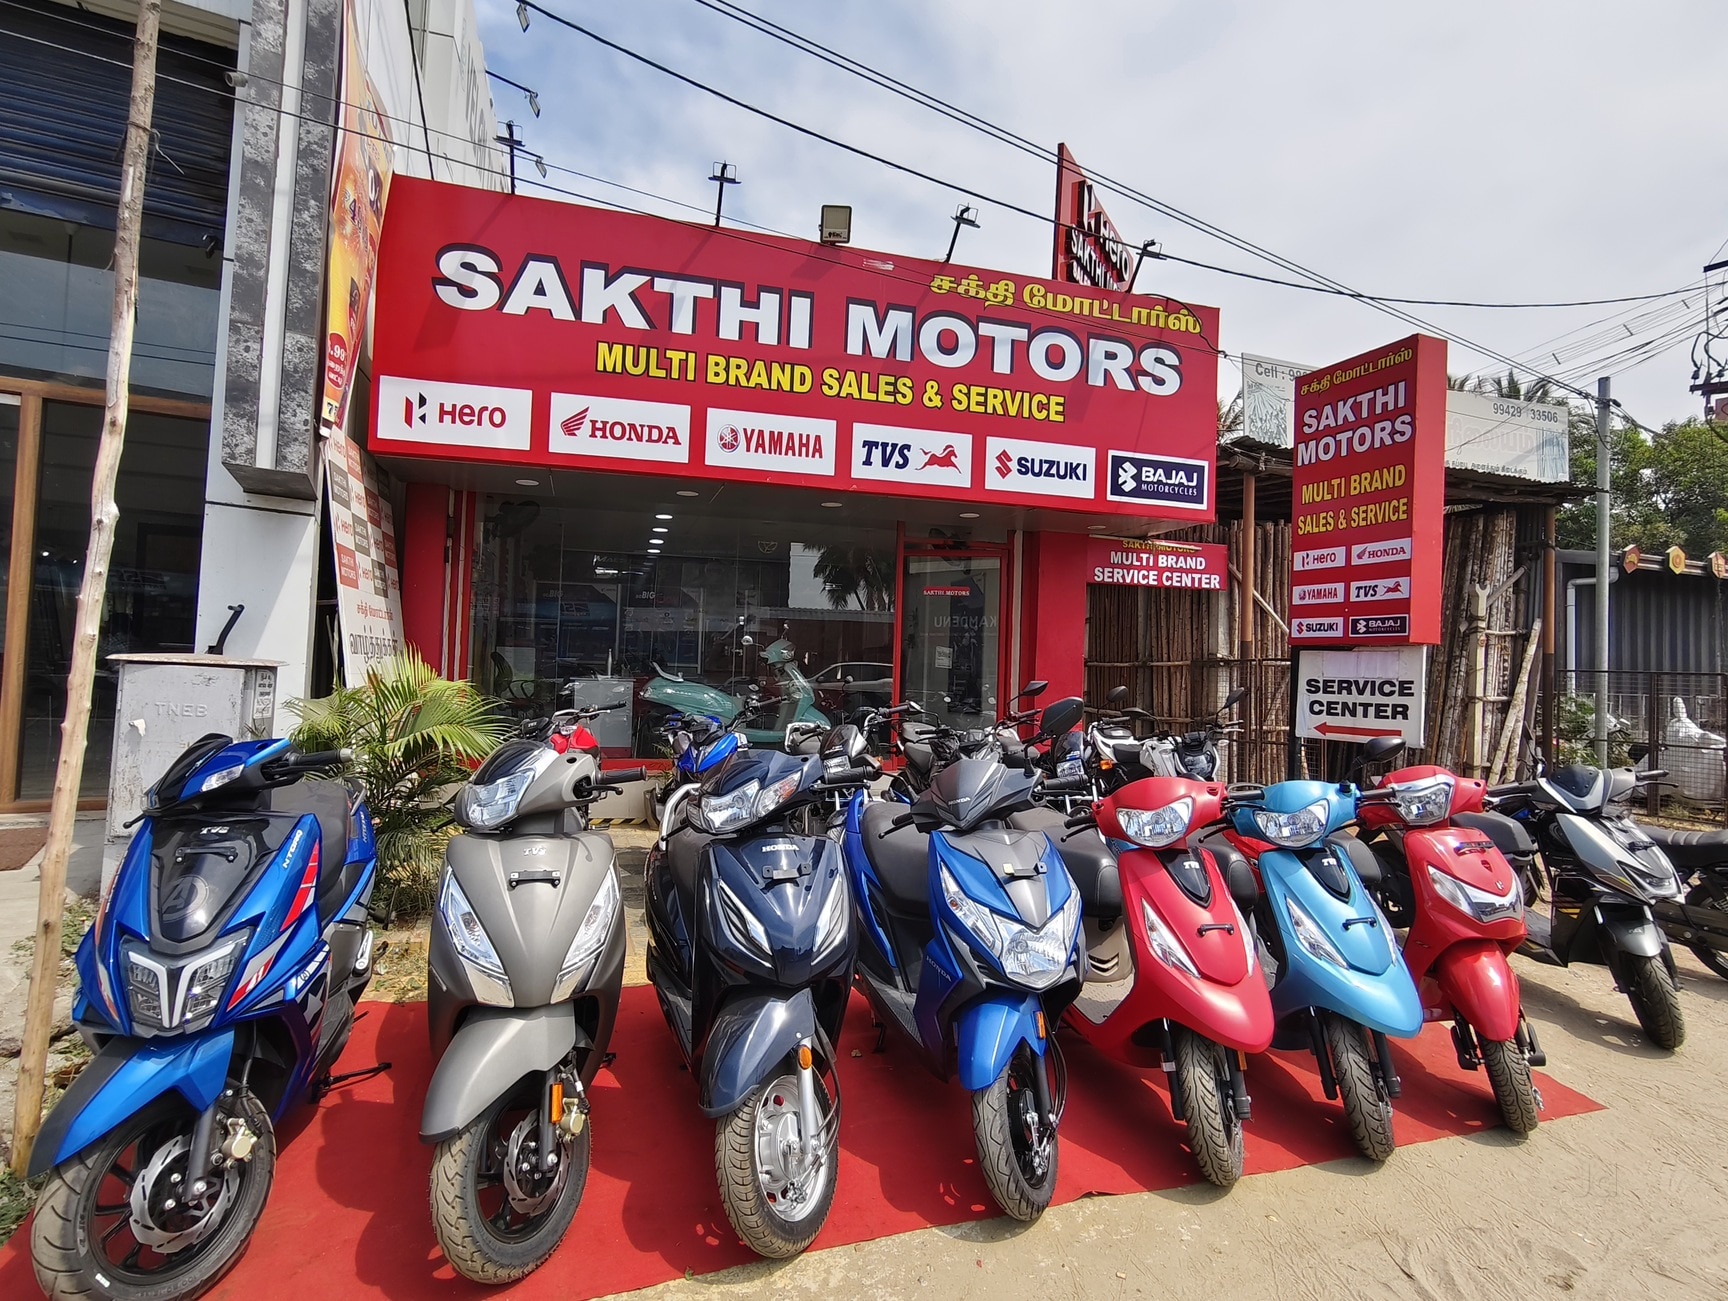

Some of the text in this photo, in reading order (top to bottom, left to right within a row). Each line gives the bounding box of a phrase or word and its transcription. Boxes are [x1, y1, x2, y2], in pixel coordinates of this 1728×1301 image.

[1071, 224, 1106, 289] SAKTHI
[1100, 211, 1129, 282] Hero
[930, 273, 1202, 334] சக்தி மோட்டார்ஸ்
[432, 243, 1183, 396] SAKTHI MOTORS
[1255, 362, 1278, 379] Cell
[1300, 347, 1413, 396] சக்தி மோட்டார்ஸ்
[596, 340, 1066, 423] MULTI BRAND SALES & SERVICE
[438, 402, 507, 429] Hero
[1302, 381, 1407, 434] SAKTHI
[1492, 402, 1559, 423] 99429 33506
[588, 418, 682, 447] HONDA
[1297, 414, 1413, 467] MOTORS
[742, 427, 824, 460] YAMAHA
[861, 438, 911, 470] TVS
[1016, 456, 1088, 482] SUZUKI
[1141, 466, 1198, 487] BAJAJ
[1140, 483, 1198, 497] MOTORCYCLES
[1301, 464, 1406, 505] MULTI BRAND
[1298, 497, 1408, 536] SALES & SERVICE
[1110, 551, 1206, 570] MULTI BRAND
[1312, 551, 1337, 565] Hero
[1367, 546, 1407, 560] HONDA
[1094, 567, 1220, 589] SERVICE CENTER
[1306, 586, 1339, 601] YAMAHA
[1355, 584, 1379, 599] TVS
[1305, 622, 1339, 633] SUZUKI
[1368, 619, 1401, 628] BAJAJ
[1305, 678, 1415, 697] SERVICE
[155, 702, 208, 718] TNEB
[1308, 699, 1410, 720] CENTER
[199, 826, 230, 835] TVS
[523, 847, 547, 856] TVS
[761, 844, 800, 852] HONDA
[926, 954, 952, 982] HONDA
